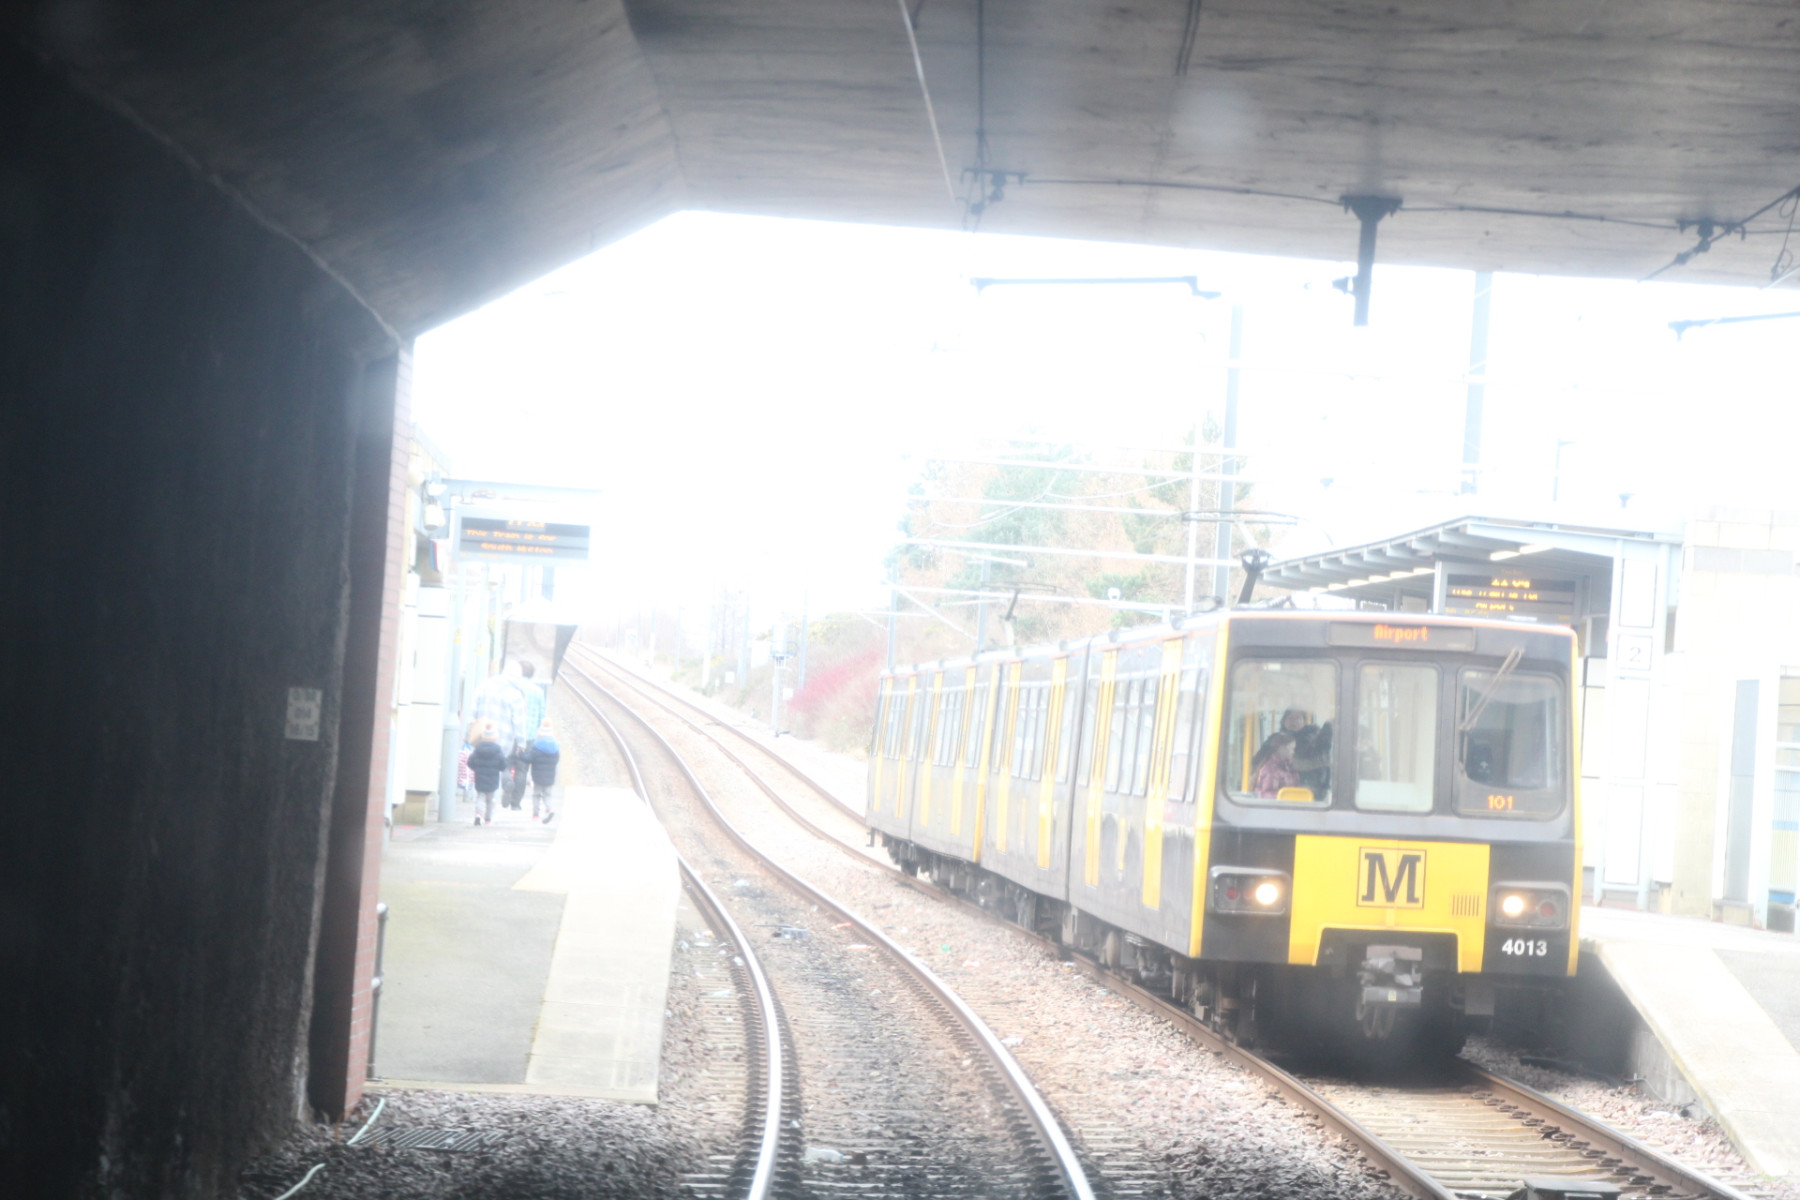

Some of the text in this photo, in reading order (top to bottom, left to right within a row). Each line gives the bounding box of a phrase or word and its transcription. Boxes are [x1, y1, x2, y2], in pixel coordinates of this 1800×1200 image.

[1374, 624, 1428, 643] Airport
[1630, 647, 1641, 662] 2
[1488, 795, 1513, 809] 101
[1361, 852, 1422, 904] M
[1501, 938, 1548, 956] 4013
